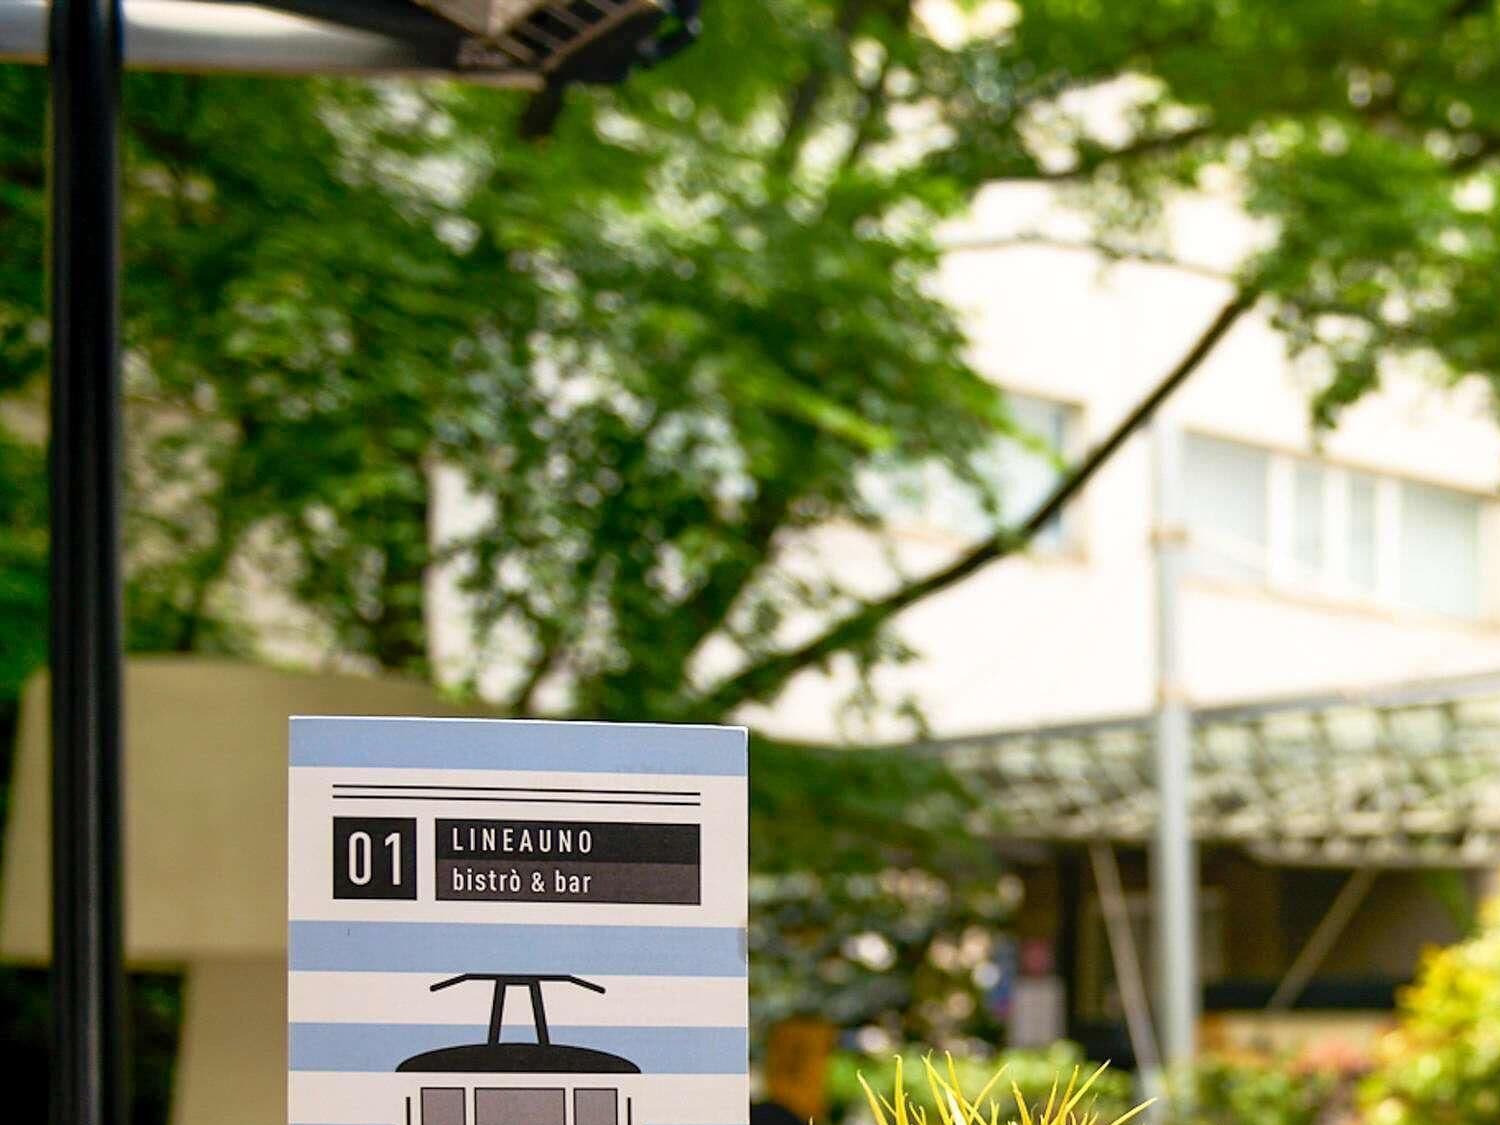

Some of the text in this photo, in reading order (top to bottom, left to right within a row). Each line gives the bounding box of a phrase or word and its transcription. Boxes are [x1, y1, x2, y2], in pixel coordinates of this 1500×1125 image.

[452, 826, 592, 854] LINEAUNO
[347, 830, 402, 886] 01
[452, 867, 592, 894] bistrò & bar
